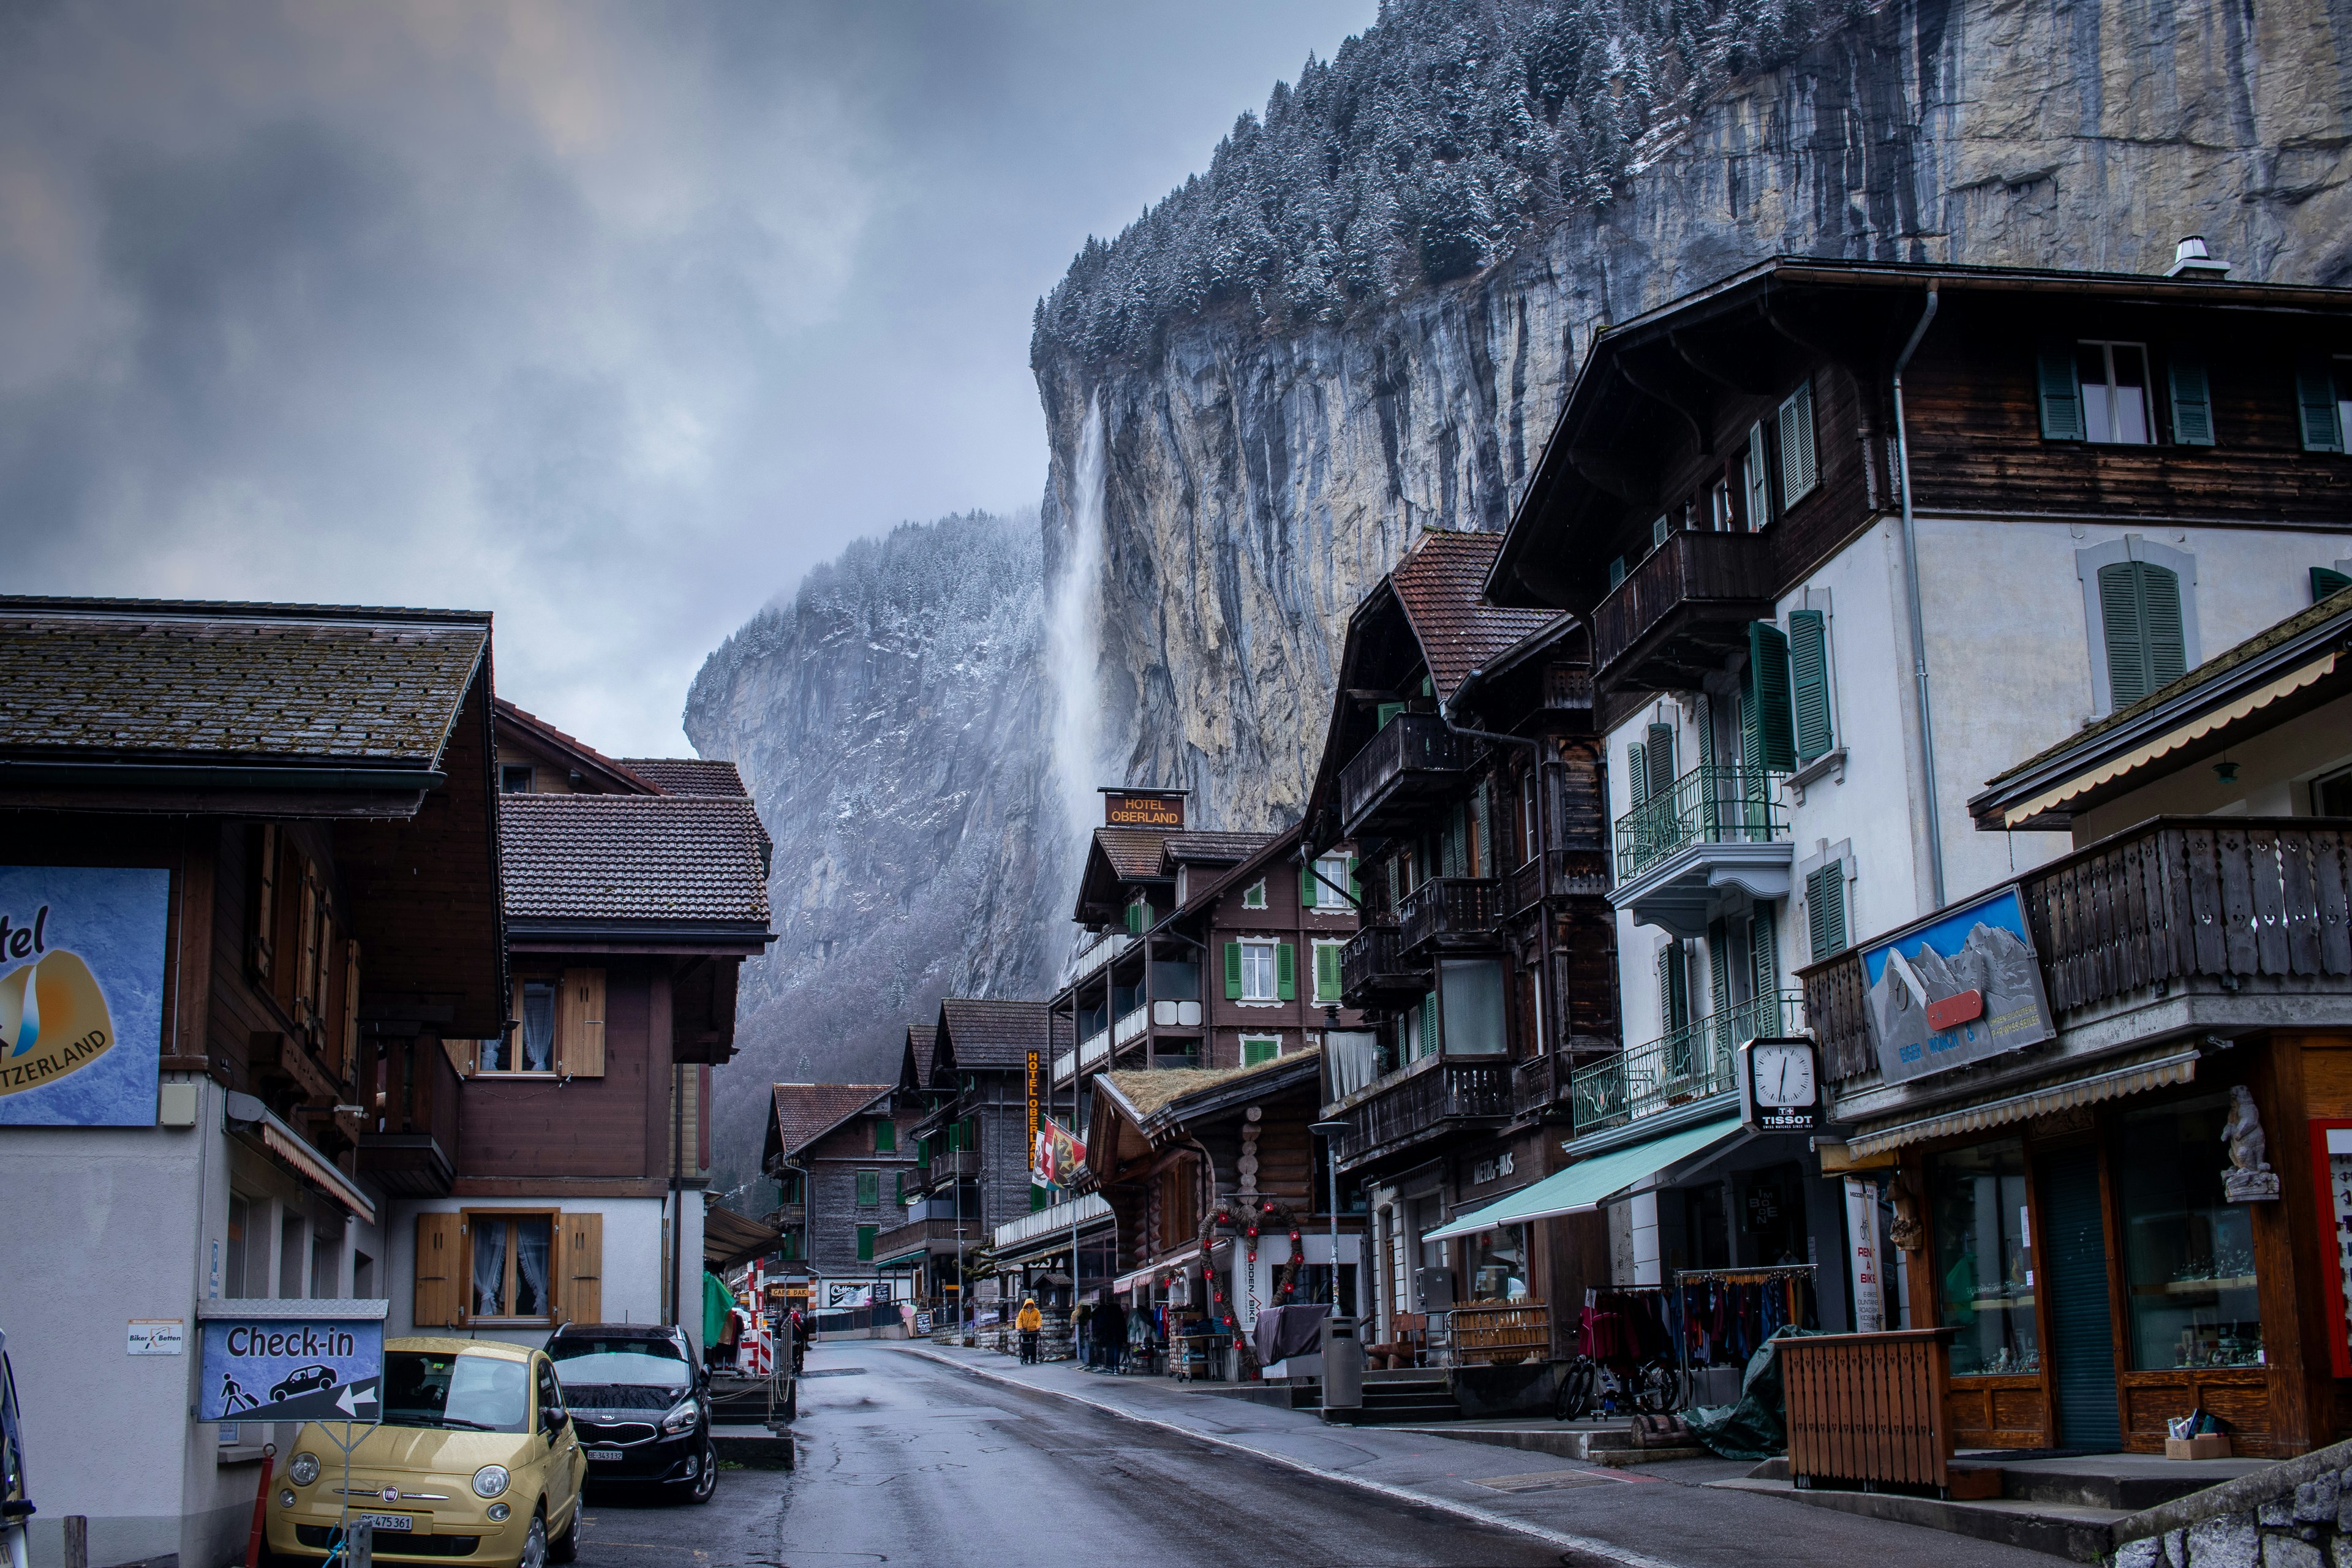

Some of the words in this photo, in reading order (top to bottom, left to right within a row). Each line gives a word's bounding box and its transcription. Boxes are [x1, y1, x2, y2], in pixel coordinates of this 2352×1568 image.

[1125, 799, 1166, 810] HOTEL
[1111, 811, 1178, 823] OBERLAND
[1899, 1042, 1921, 1063] EIGER
[1927, 1031, 1959, 1055] MÖNCH
[1966, 1022, 1975, 1042] &
[1028, 1052, 1038, 1096] HOTEL
[1762, 1116, 1812, 1125] TISSOT
[1858, 1247, 1875, 1257] REN
[1866, 1261, 1872, 1270] A
[227, 1327, 353, 1357] Check-in
